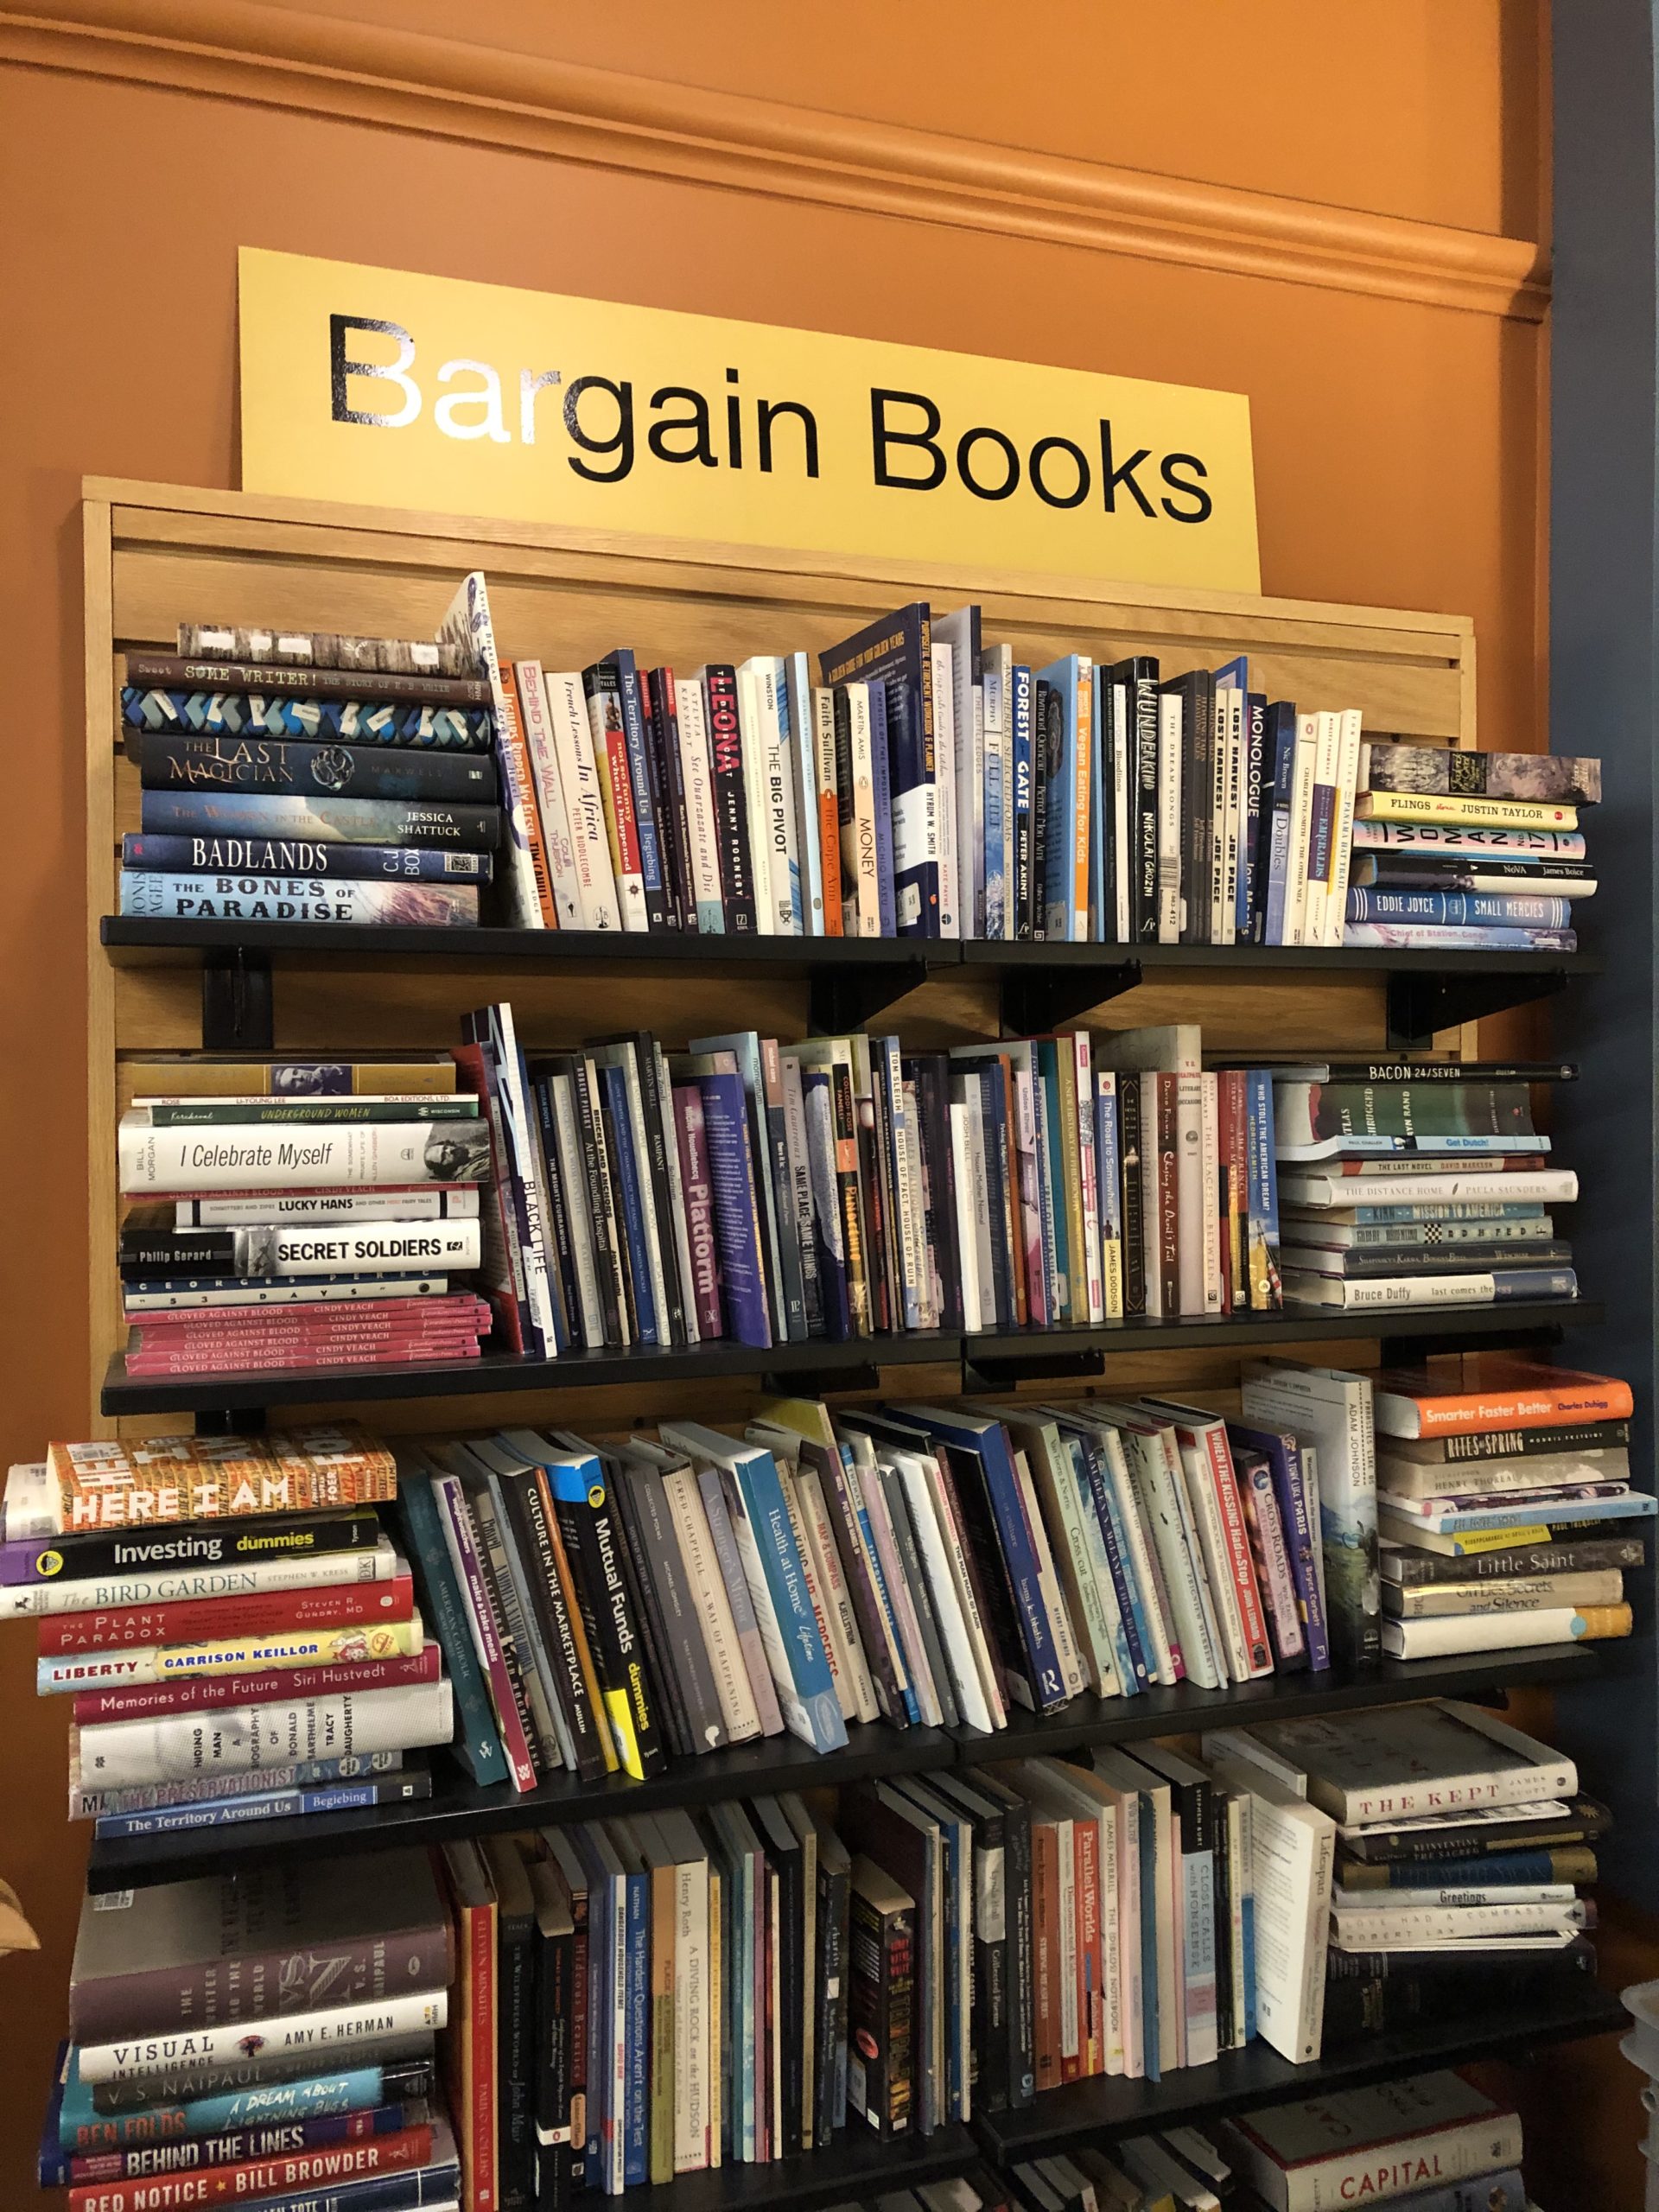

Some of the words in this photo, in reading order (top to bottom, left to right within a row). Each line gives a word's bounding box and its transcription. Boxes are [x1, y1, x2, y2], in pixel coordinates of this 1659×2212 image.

[329, 314, 820, 483] Bargain
[870, 388, 1211, 523] Books
[184, 665, 231, 681] SOME
[242, 669, 317, 686] WRITER!
[624, 674, 634, 691] The
[765, 673, 774, 710] WINSTON
[564, 681, 575, 717] French
[821, 696, 830, 724] Faith
[1016, 672, 1030, 741] FOREST
[625, 695, 640, 750] Territory
[856, 700, 865, 734] MARTIN
[1137, 678, 1158, 790] WUNDERKIND
[184, 741, 212, 753] THE
[212, 737, 292, 765] LAST
[570, 720, 582, 761] Lessons
[767, 744, 781, 771] THE
[822, 728, 831, 782] Sullivan
[1078, 728, 1088, 763] Vegan
[168, 755, 293, 786] MAGICIAN
[577, 765, 593, 782] In
[634, 754, 647, 796] Around
[1247, 706, 1265, 817] MONOLOGUE
[771, 777, 783, 804] BIG
[1016, 762, 1029, 809] GATE
[1078, 766, 1087, 805] Eating
[406, 810, 454, 823] JESSICA
[579, 788, 600, 841] Africa
[639, 798, 648, 813] Us
[728, 792, 737, 831] JENNY
[1391, 799, 1430, 810] FLINGS
[1461, 805, 1498, 816] JUSTIN
[1503, 808, 1542, 819] TAYLOR
[397, 824, 461, 836] SHATTUCK
[772, 809, 787, 855] PIVOT
[1077, 828, 1085, 864] Kids
[1142, 813, 1154, 858] NIKOLAI
[1273, 817, 1287, 871] Doubles
[192, 838, 327, 871] BADLANDS
[404, 848, 420, 876] BOX
[860, 818, 874, 878] MONEY
[732, 839, 743, 897] ROGNEBY
[1019, 861, 1027, 900] AKINTI
[1143, 861, 1154, 897] GROZNI
[173, 882, 204, 893] THE
[216, 879, 326, 897] BONES
[336, 887, 355, 897] OF
[1376, 895, 1404, 912] EDDIE
[1407, 898, 1434, 913] JOYCE
[176, 899, 353, 921] PARADISE
[1475, 900, 1501, 916] SMALL
[1507, 902, 1543, 918] MERCIES
[1370, 1067, 1411, 1080] BACON
[1414, 1068, 1460, 1077] 24/SEVEN
[893, 1077, 902, 1111] SLEIGH
[1103, 1102, 1112, 1120] The
[1103, 1122, 1112, 1142] Road
[181, 1146, 186, 1166] I
[193, 1144, 272, 1167] Celebrate
[277, 1143, 334, 1166] Myself
[1105, 1145, 1112, 1154] to
[1260, 1141, 1268, 1180] AMERICAN
[1106, 1158, 1115, 1215] Somewhere
[278, 1199, 317, 1211] LUCKY
[320, 1198, 353, 1210] HANS
[899, 1171, 906, 1179] OF
[906, 1249, 912, 1260] OF
[139, 1250, 171, 1262] Philip
[175, 1249, 213, 1262] Gerard
[277, 1242, 349, 1262] SECRET
[354, 1239, 442, 1257] SOLDIERS
[689, 1185, 715, 1294] Platform
[1109, 1277, 1118, 1313] DODSON
[1354, 1289, 1382, 1300] Bruce
[1386, 1288, 1411, 1301] Duffy
[208, 1310, 249, 1319] AGAINST
[251, 1308, 283, 1317] BLOOD
[1349, 1403, 1357, 1432] ADAM
[1427, 1408, 1475, 1423] Smarter
[1479, 1406, 1514, 1418] Faster
[1518, 1402, 1552, 1414] Better
[1351, 1437, 1360, 1487] JOHNSON
[1447, 1438, 1478, 1457] RITES
[1485, 1433, 1524, 1454] SPRING
[73, 1489, 179, 1523] HERE
[194, 1484, 222, 1513] I
[231, 1478, 289, 1508] AM
[527, 1488, 546, 1549] CULTURE
[114, 1537, 222, 1564] Investing
[237, 1532, 315, 1551] dummies
[543, 1550, 551, 1566] IN
[1478, 1558, 1522, 1574] Little
[1530, 1554, 1575, 1570] Saint
[96, 1583, 152, 1605] BIRD
[158, 1573, 257, 1597] GARDEN
[547, 1569, 561, 1596] THE
[61, 1627, 167, 1645] PARADOX
[95, 1615, 166, 1630] PLANT
[594, 1518, 620, 1591] Mutual
[610, 1590, 633, 1654] Funds
[628, 1662, 649, 1731] dummies
[54, 1662, 137, 1681] LIBERTY
[165, 1652, 245, 1669] GARRISON
[253, 1644, 319, 1658] KEILLOR
[552, 1602, 583, 1696] MARKETPLACE
[100, 1693, 175, 1712] Memories
[181, 1686, 198, 1700] of
[203, 1685, 226, 1698] the
[232, 1678, 278, 1695] Future
[294, 1673, 319, 1687] Siri
[322, 1666, 385, 1681] Hustvedt
[574, 1704, 587, 1734] MULLIN
[1359, 1795, 1414, 1815] THE
[1427, 1783, 1500, 1806] KEPT
[1083, 1831, 1093, 1885] Parallel
[1315, 1835, 1331, 1896] Lifespan
[1440, 1891, 1486, 1904] Greetings
[1084, 1890, 1093, 1943] Worlds
[285, 2030, 315, 2045] AMY
[337, 2017, 394, 2037] HERMAN
[113, 2036, 215, 2064] VISUAL
[127, 2145, 199, 2177] BEHIND
[206, 2134, 242, 2161] THE
[249, 2126, 304, 2156] LINES
[134, 2179, 207, 2208] NOTICE
[235, 2165, 277, 2192] BILL
[286, 2147, 379, 2184] BROWDER
[1340, 2154, 1444, 2200] CAPITAL
